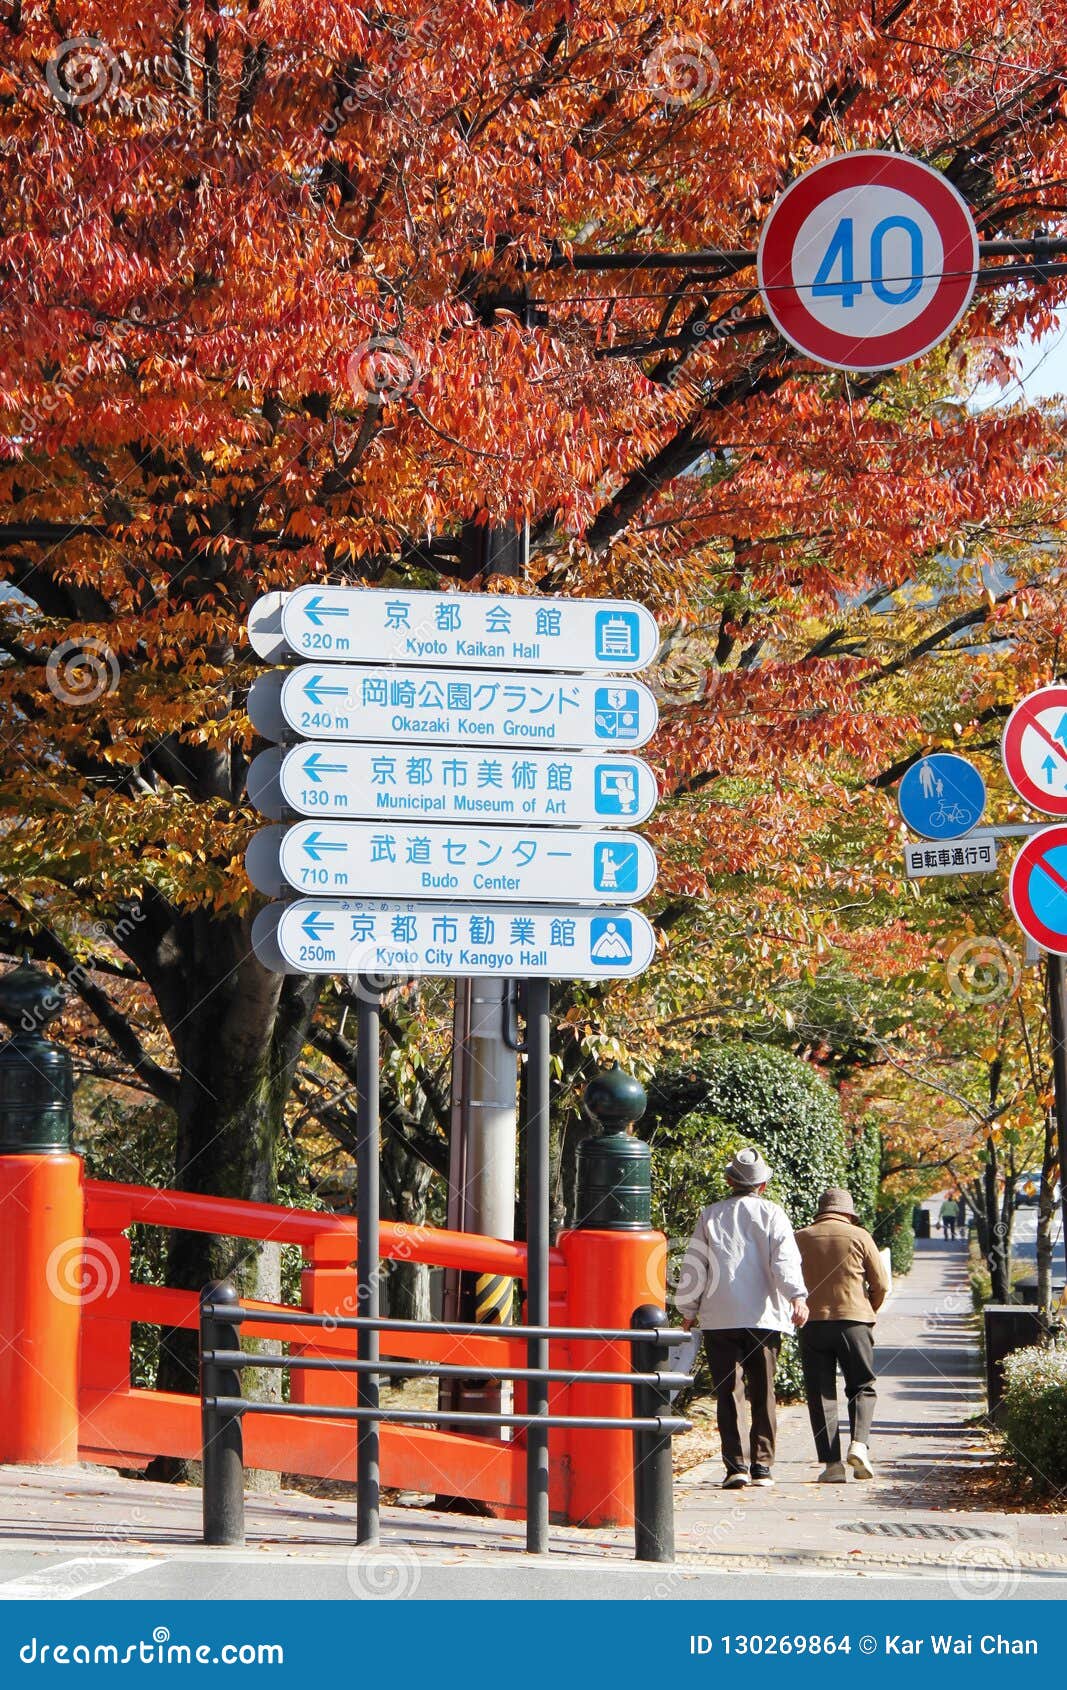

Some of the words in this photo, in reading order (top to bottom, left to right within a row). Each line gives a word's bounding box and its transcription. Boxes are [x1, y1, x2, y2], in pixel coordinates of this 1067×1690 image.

[811, 215, 924, 308] 40
[384, 599, 562, 638] 京都会館
[302, 632, 332, 650] 320
[335, 637, 350, 650] m
[405, 637, 449, 657] Kyoto
[455, 639, 506, 657] Kaikan
[512, 641, 541, 659] Hall
[361, 677, 581, 715] 岡崎公園グランド
[301, 711, 333, 729] 240
[334, 716, 350, 729] m
[391, 714, 451, 734] Okazaki
[457, 718, 495, 736] Koen
[501, 719, 556, 739] Ground
[370, 755, 574, 792] 京都市美術館
[301, 789, 331, 807] 130
[333, 793, 349, 807] m
[375, 791, 447, 812] Municipal
[452, 794, 515, 813] Museum
[521, 797, 537, 813] of
[544, 798, 567, 815] Art
[369, 833, 573, 868] 武道センター
[910, 845, 992, 870] 自転車通行可
[300, 867, 330, 885] 710
[333, 872, 349, 885] m
[420, 871, 460, 890] Budo
[472, 873, 521, 891] Center
[349, 911, 577, 948] 京都市勧業館
[298, 944, 337, 962] 250m
[375, 947, 420, 968] Kyoto
[423, 947, 454, 967] City
[458, 949, 514, 971] Kangyo
[519, 950, 548, 967] Hall
